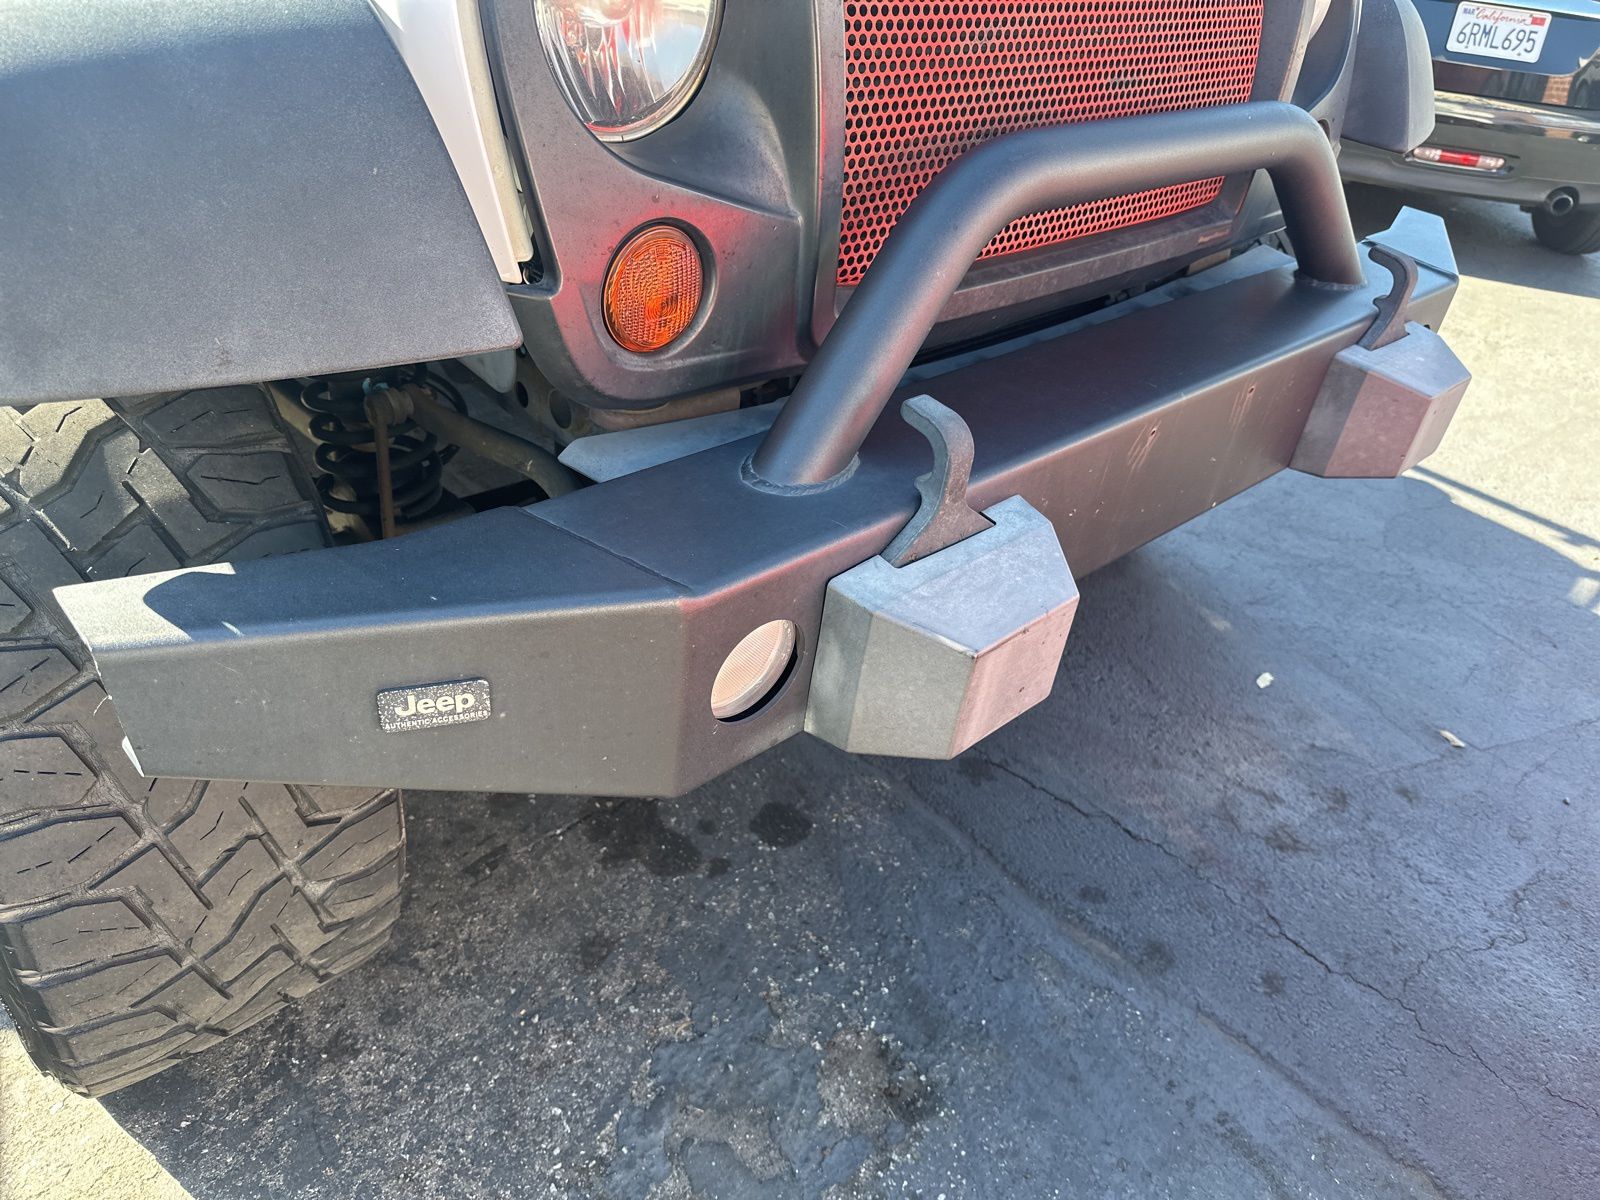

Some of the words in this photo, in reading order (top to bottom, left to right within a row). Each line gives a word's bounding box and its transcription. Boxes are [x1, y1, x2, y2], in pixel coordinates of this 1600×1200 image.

[1475, 8, 1530, 26] California
[1456, 22, 1538, 54] 6RML695
[394, 692, 476, 717] Jeep
[384, 718, 432, 730] AUTHENTIC
[431, 710, 489, 724] ACCESSORIES
